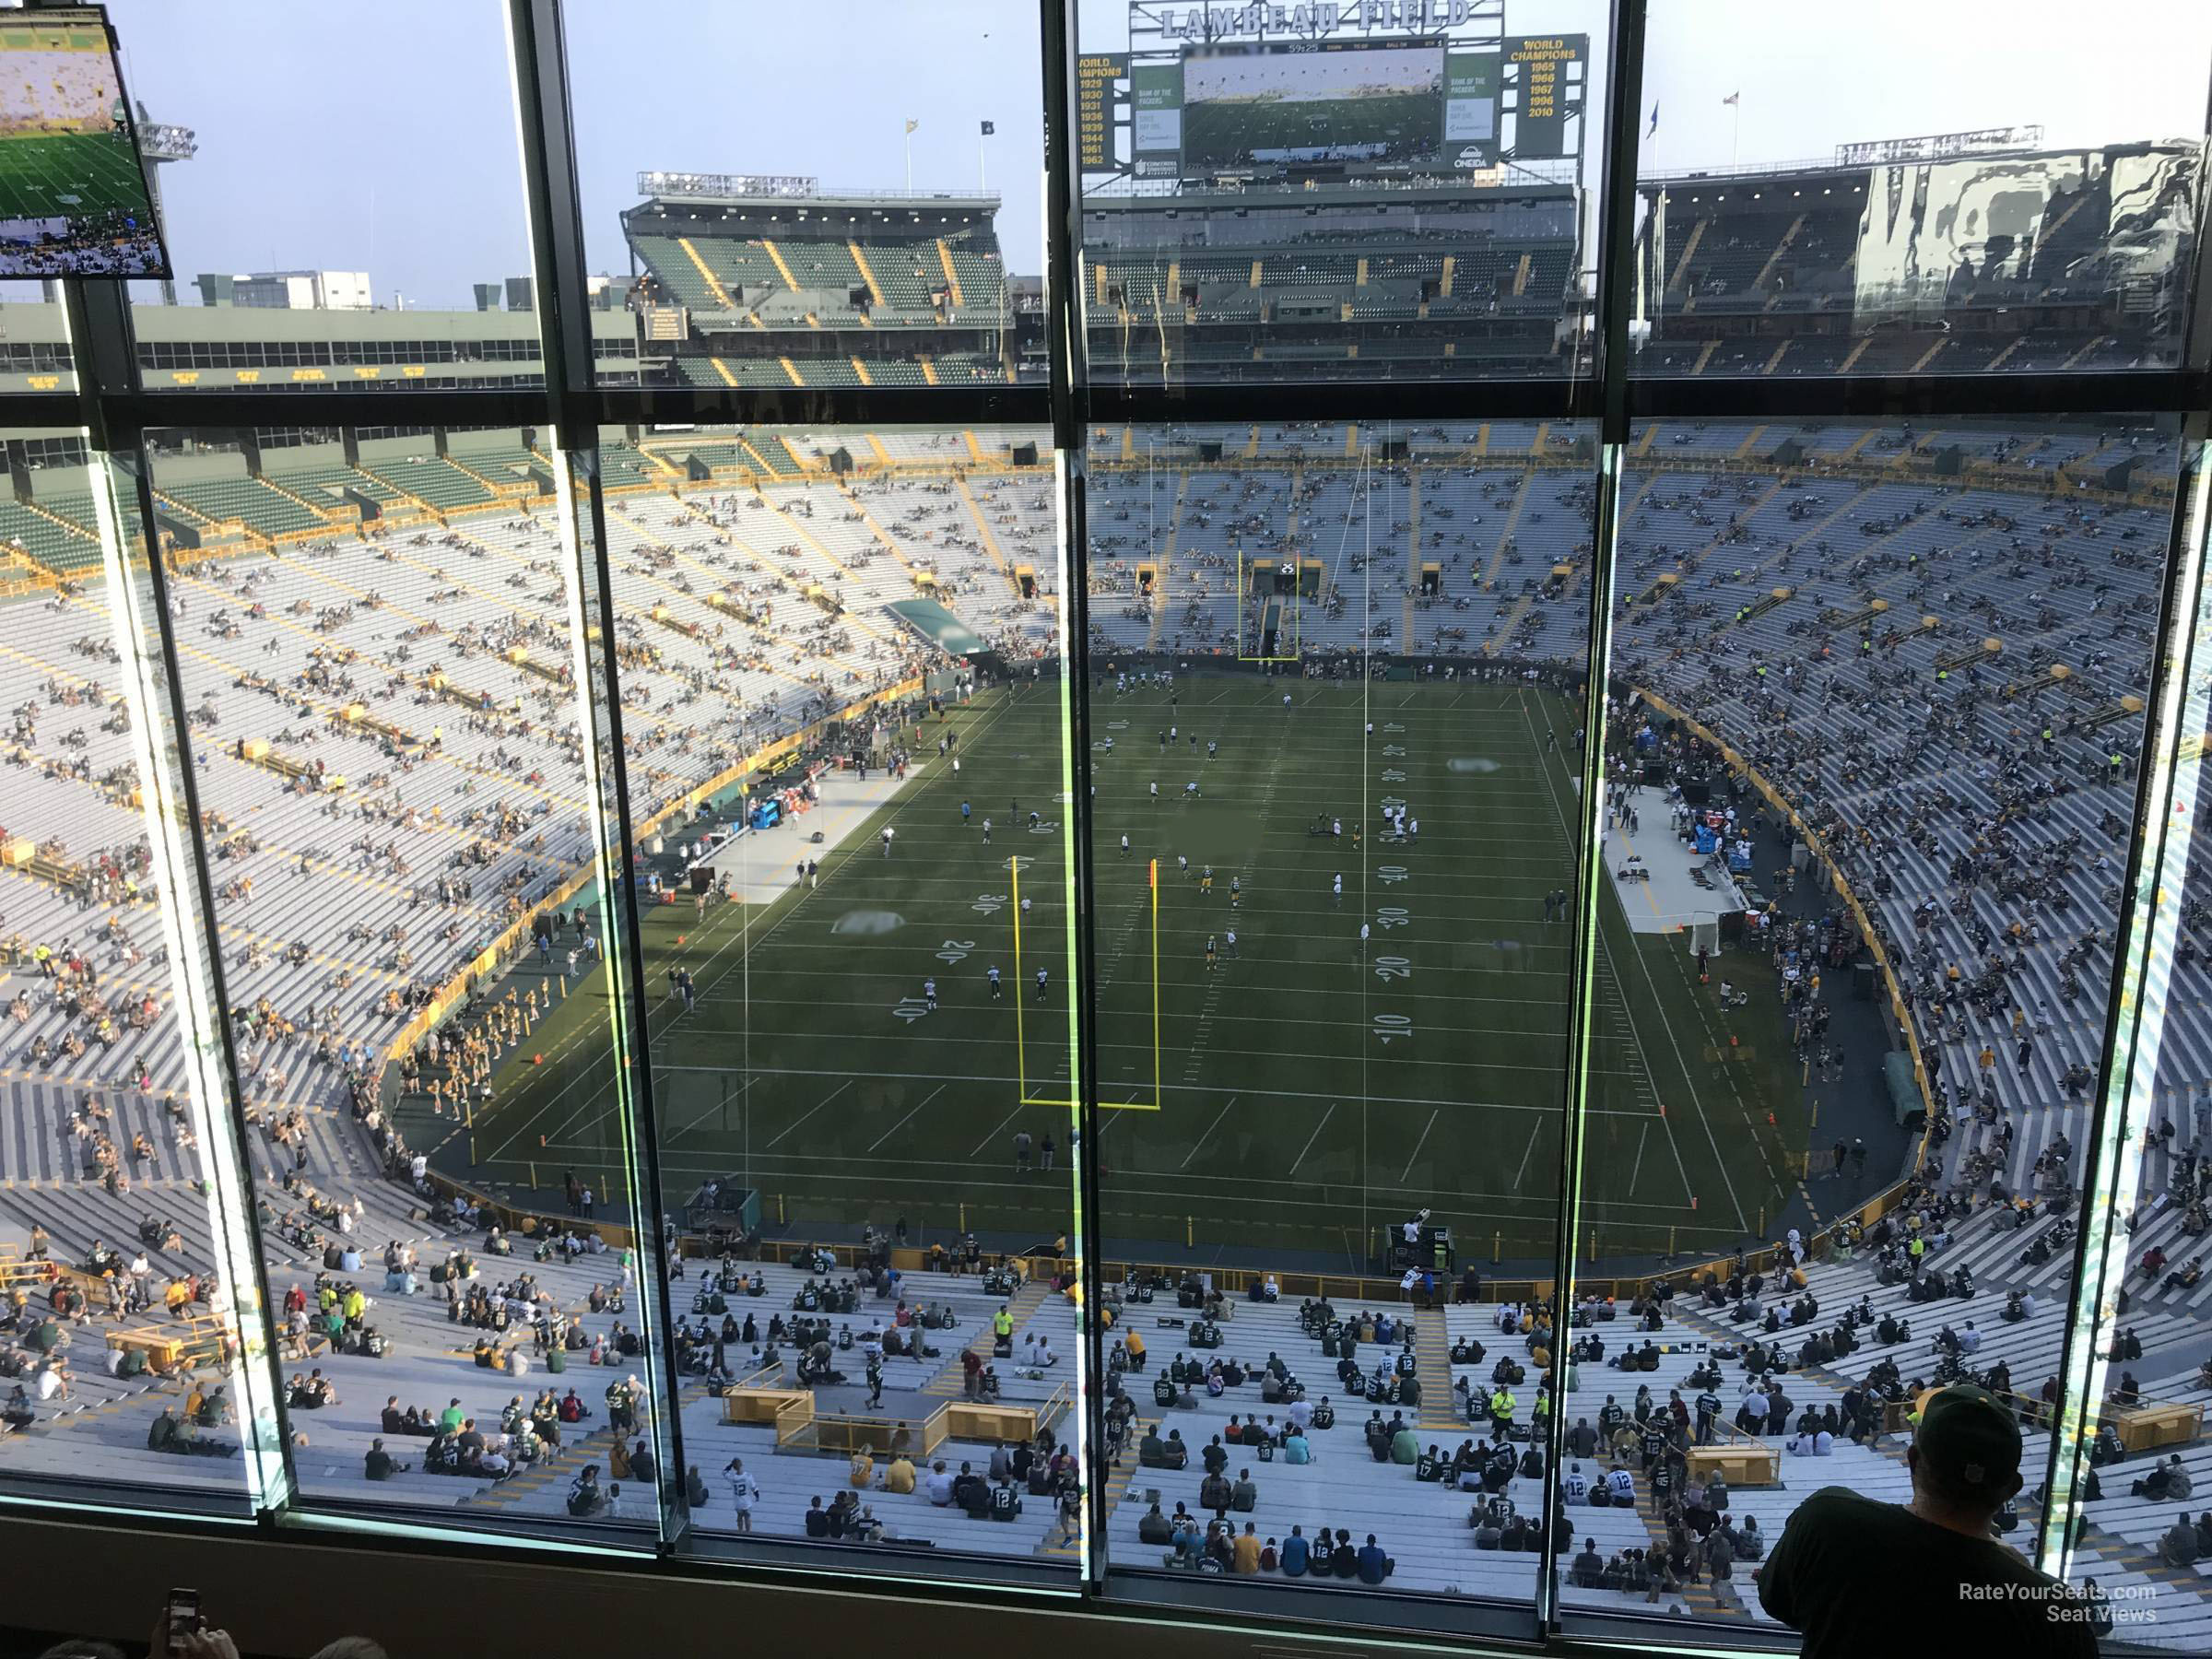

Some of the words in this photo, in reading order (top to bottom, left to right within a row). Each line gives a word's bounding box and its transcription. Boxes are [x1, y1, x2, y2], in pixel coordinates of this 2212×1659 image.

[1161, 3, 1339, 38] LAMBEAU
[1358, 0, 1470, 30] FIELD
[1524, 40, 1563, 51] WORLD
[1511, 49, 1576, 62] CHAMPIONS
[1532, 61, 1556, 73] 1965
[1080, 79, 1102, 88] 1929
[1531, 73, 1555, 84] 1966
[1531, 85, 1554, 96] 1967
[1081, 101, 1100, 111] 1931
[1530, 96, 1554, 106] 1996
[1528, 106, 1554, 118] 2010
[1081, 134, 1104, 143] 1944
[1082, 145, 1102, 154] 1961
[1082, 156, 1104, 165] 1962
[1453, 157, 1487, 168] ONEIDA
[1280, 563, 1295, 573] 25
[971, 894, 1008, 912] 30
[1377, 908, 1409, 925] 30
[935, 940, 976, 960] 20
[1375, 957, 1411, 978] 20
[892, 996, 929, 1018] 10
[1372, 1015, 1413, 1037] 10
[1964, 1280, 1974, 1291] 15
[694, 1327, 705, 1339] 12
[1205, 1331, 1214, 1342] 12
[1777, 1353, 1787, 1364] 12
[1382, 1361, 1393, 1371] 12
[1404, 1359, 1413, 1371] 12
[1471, 1405, 1483, 1416] 12
[1608, 1411, 1620, 1422] 12
[1260, 1448, 1271, 1458] 18
[1646, 1441, 1660, 1455] 12
[1419, 1464, 1432, 1477] 17
[1617, 1475, 1632, 1490] 12
[734, 1483, 747, 1497] 12
[1571, 1481, 1584, 1497] 12
[995, 1492, 1011, 1509] 12
[2003, 1500, 2017, 1513] 12
[1496, 1505, 1511, 1519] 12
[1316, 1546, 1329, 1559] 12
